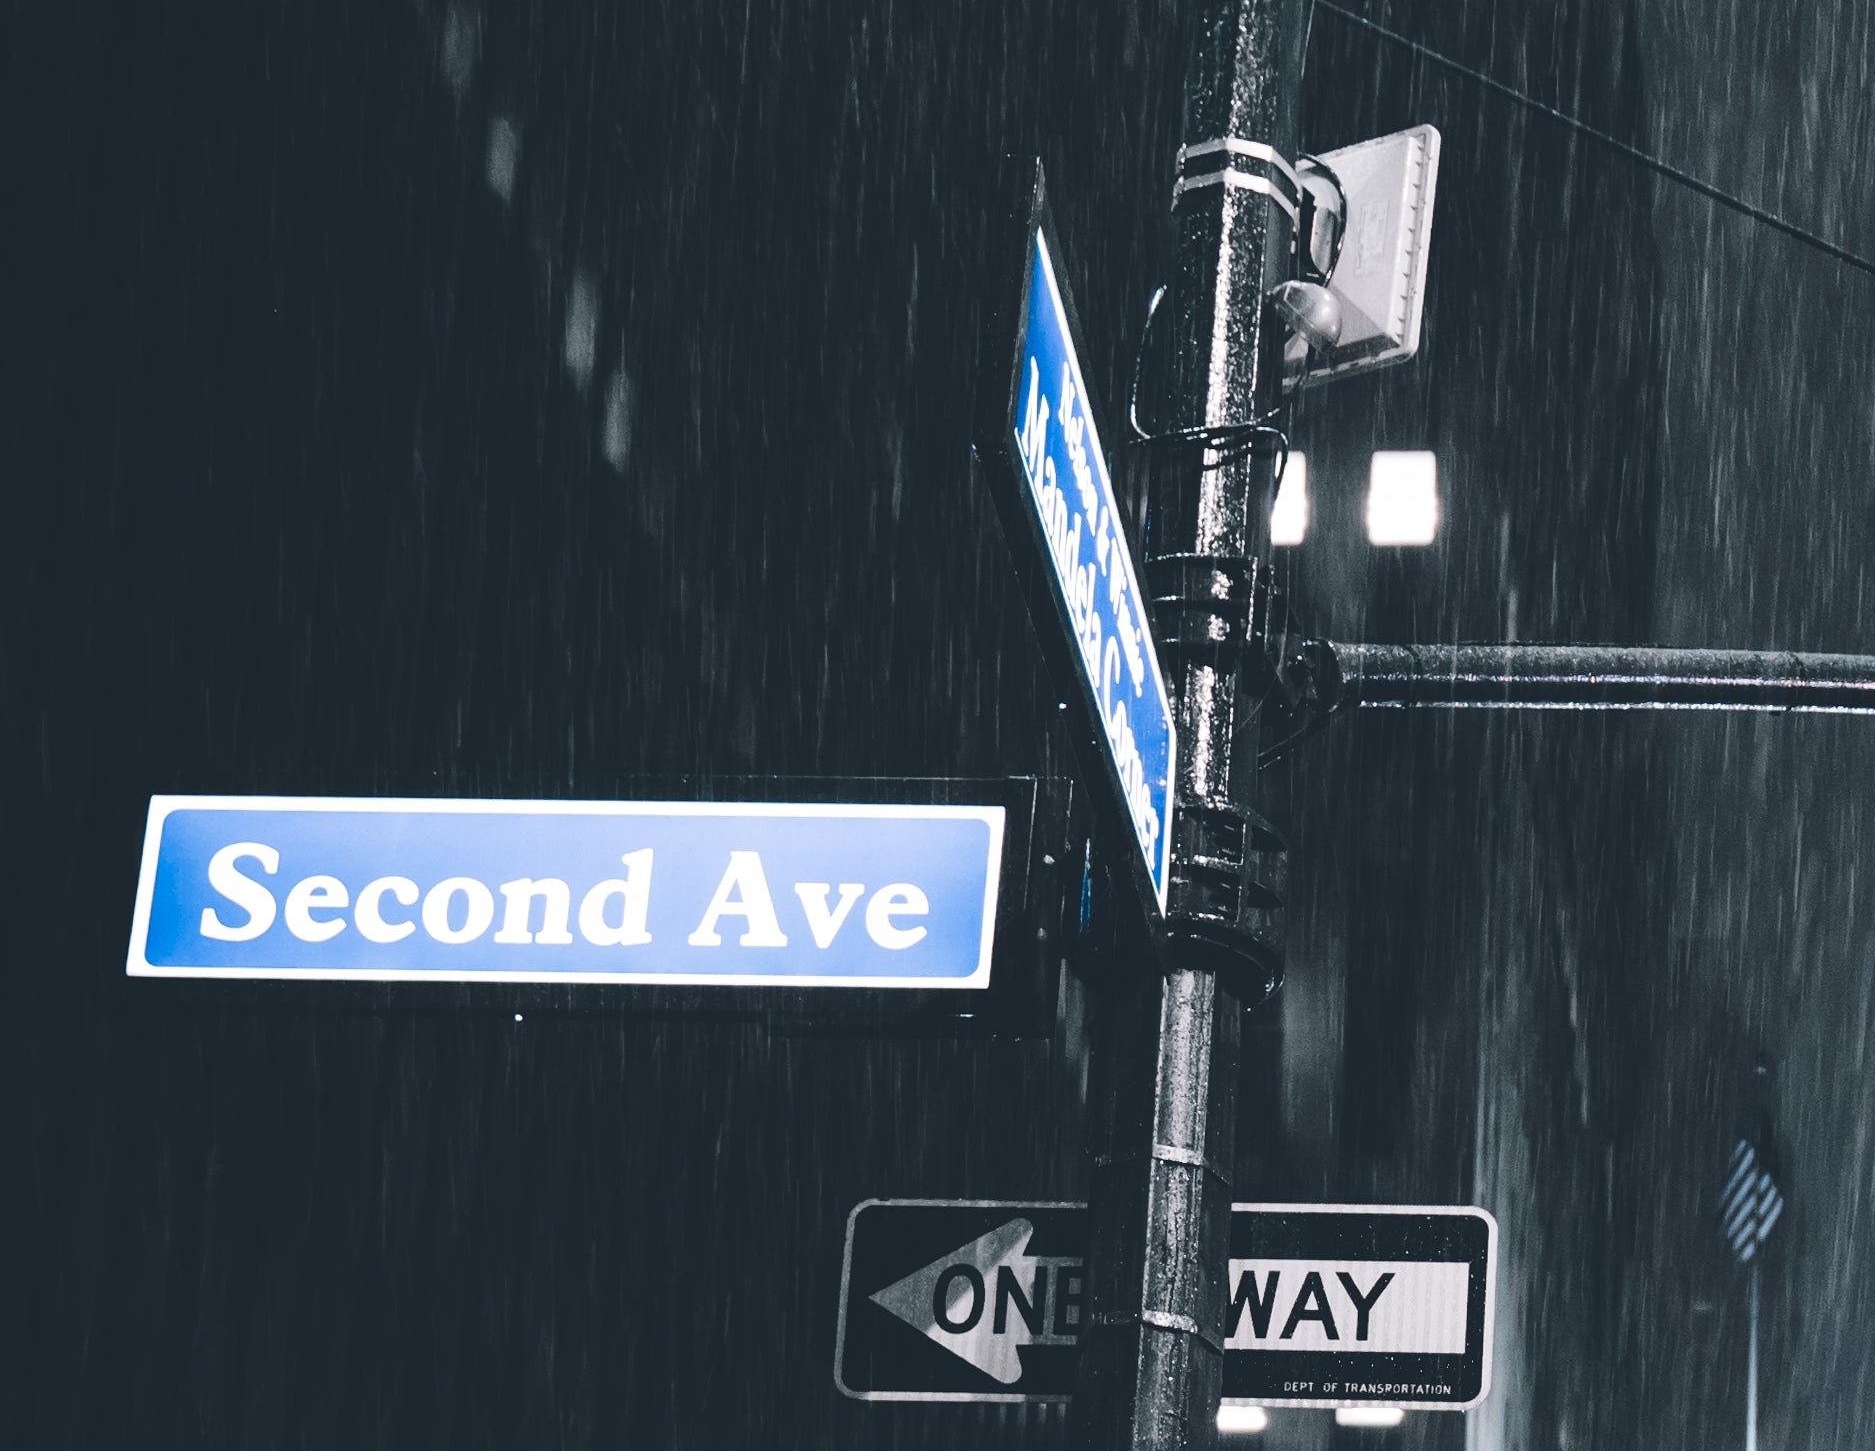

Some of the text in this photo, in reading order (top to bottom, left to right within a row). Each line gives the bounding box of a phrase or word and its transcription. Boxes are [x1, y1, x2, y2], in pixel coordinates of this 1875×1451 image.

[1059, 362, 1098, 536] Nelson
[1022, 357, 1158, 869] Mandela Corner
[200, 842, 929, 950] Second Ave
[932, 1263, 1395, 1341] ONE WAY
[1284, 1381, 1452, 1395] DEPT OF TRANSPORTATION
